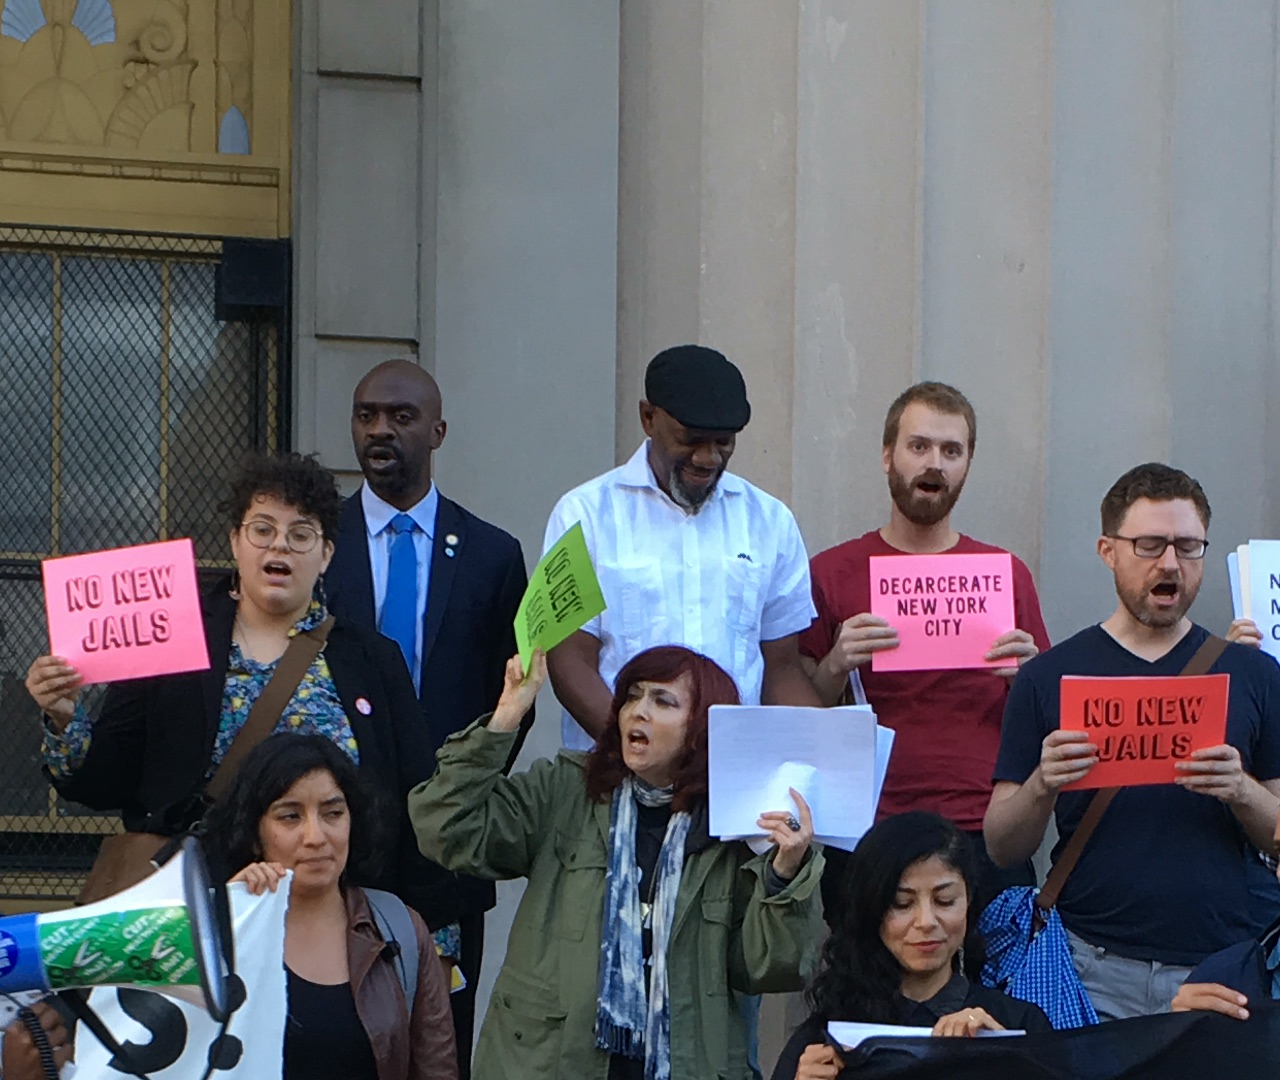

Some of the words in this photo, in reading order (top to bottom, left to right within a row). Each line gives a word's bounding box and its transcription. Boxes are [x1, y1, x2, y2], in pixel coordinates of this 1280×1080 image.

[66, 575, 103, 612] NO
[112, 564, 175, 605] NEW
[549, 573, 584, 623] NEW
[880, 575, 1002, 595] DECARCERATE
[897, 598, 937, 616] NEW
[945, 597, 987, 614] YORK
[82, 608, 170, 652] JAILS
[925, 619, 962, 637] CITY
[1084, 697, 1125, 728] NO
[1137, 696, 1207, 726] NEW
[1096, 732, 1192, 762] JAILS
